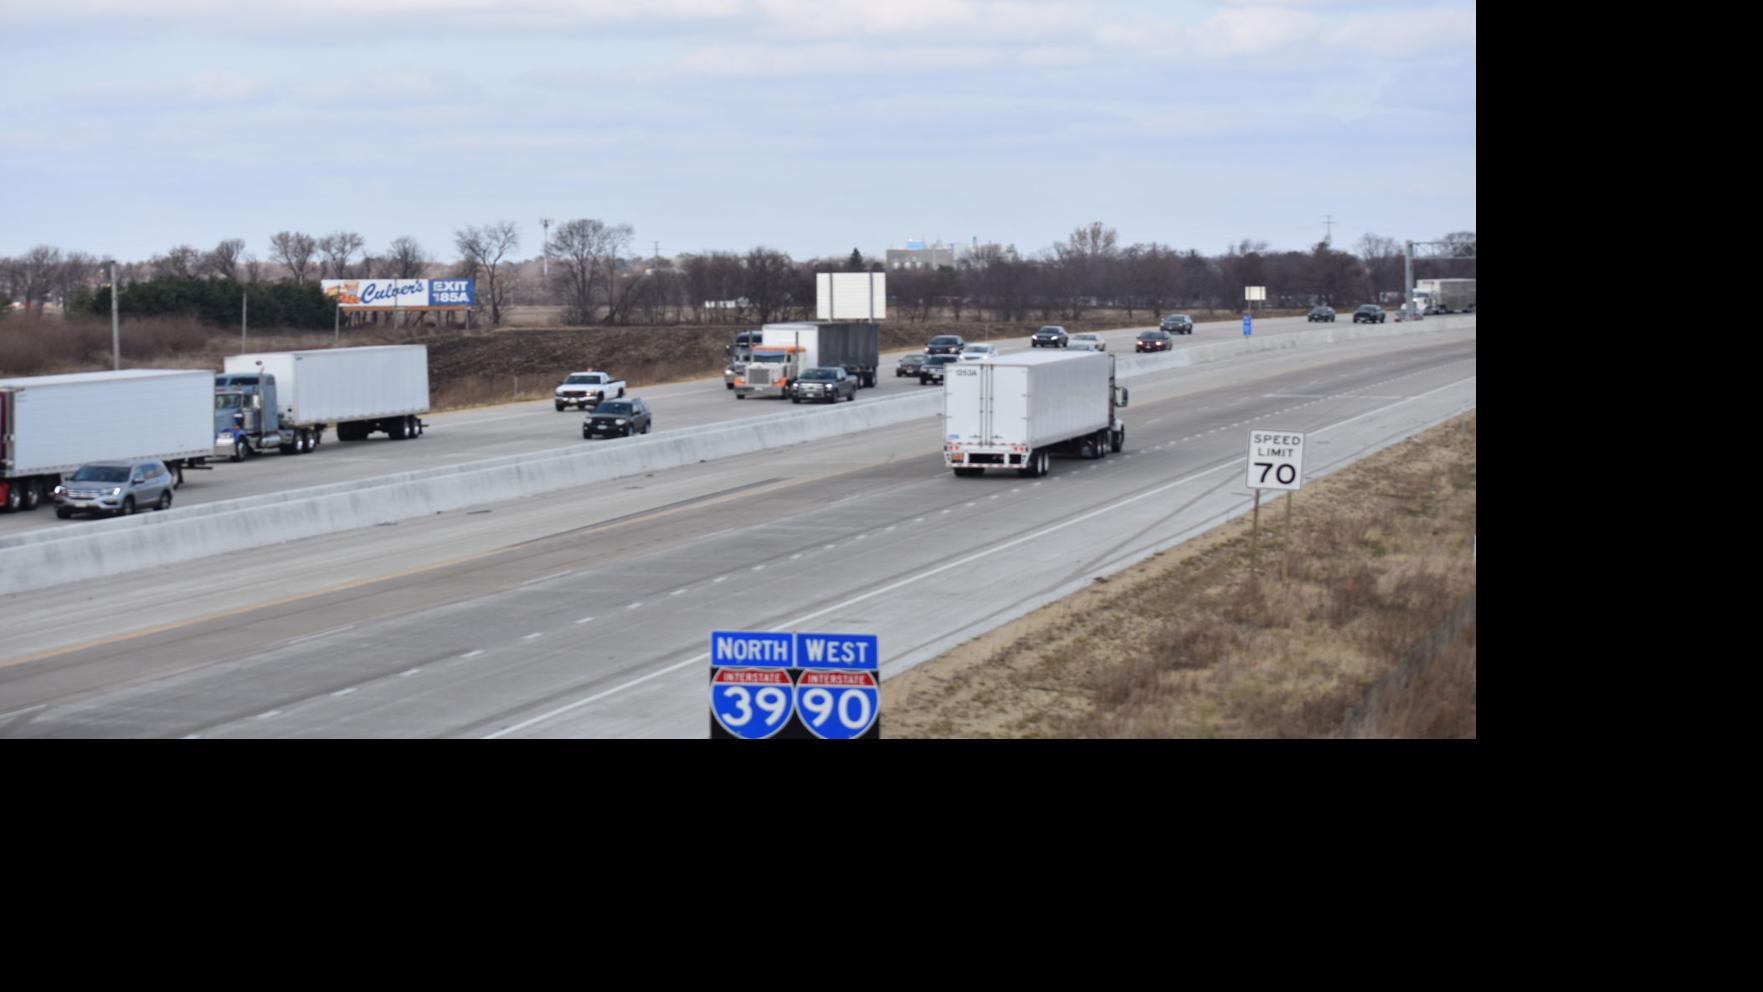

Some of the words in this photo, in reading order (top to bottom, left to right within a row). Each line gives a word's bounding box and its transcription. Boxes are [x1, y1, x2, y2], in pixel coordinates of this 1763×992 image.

[360, 280, 424, 304] Culver's
[433, 281, 469, 292] EXIT
[433, 292, 470, 303] 185A
[1253, 434, 1302, 446] SPEED
[1257, 447, 1294, 458] LIMIT
[1254, 462, 1296, 485] 70
[717, 636, 788, 661] NORTH
[805, 638, 869, 663] WEST
[723, 672, 782, 683] INTERSTATE
[807, 674, 865, 685] INTERSTATE
[722, 686, 787, 726] 39
[802, 688, 871, 729] 90
